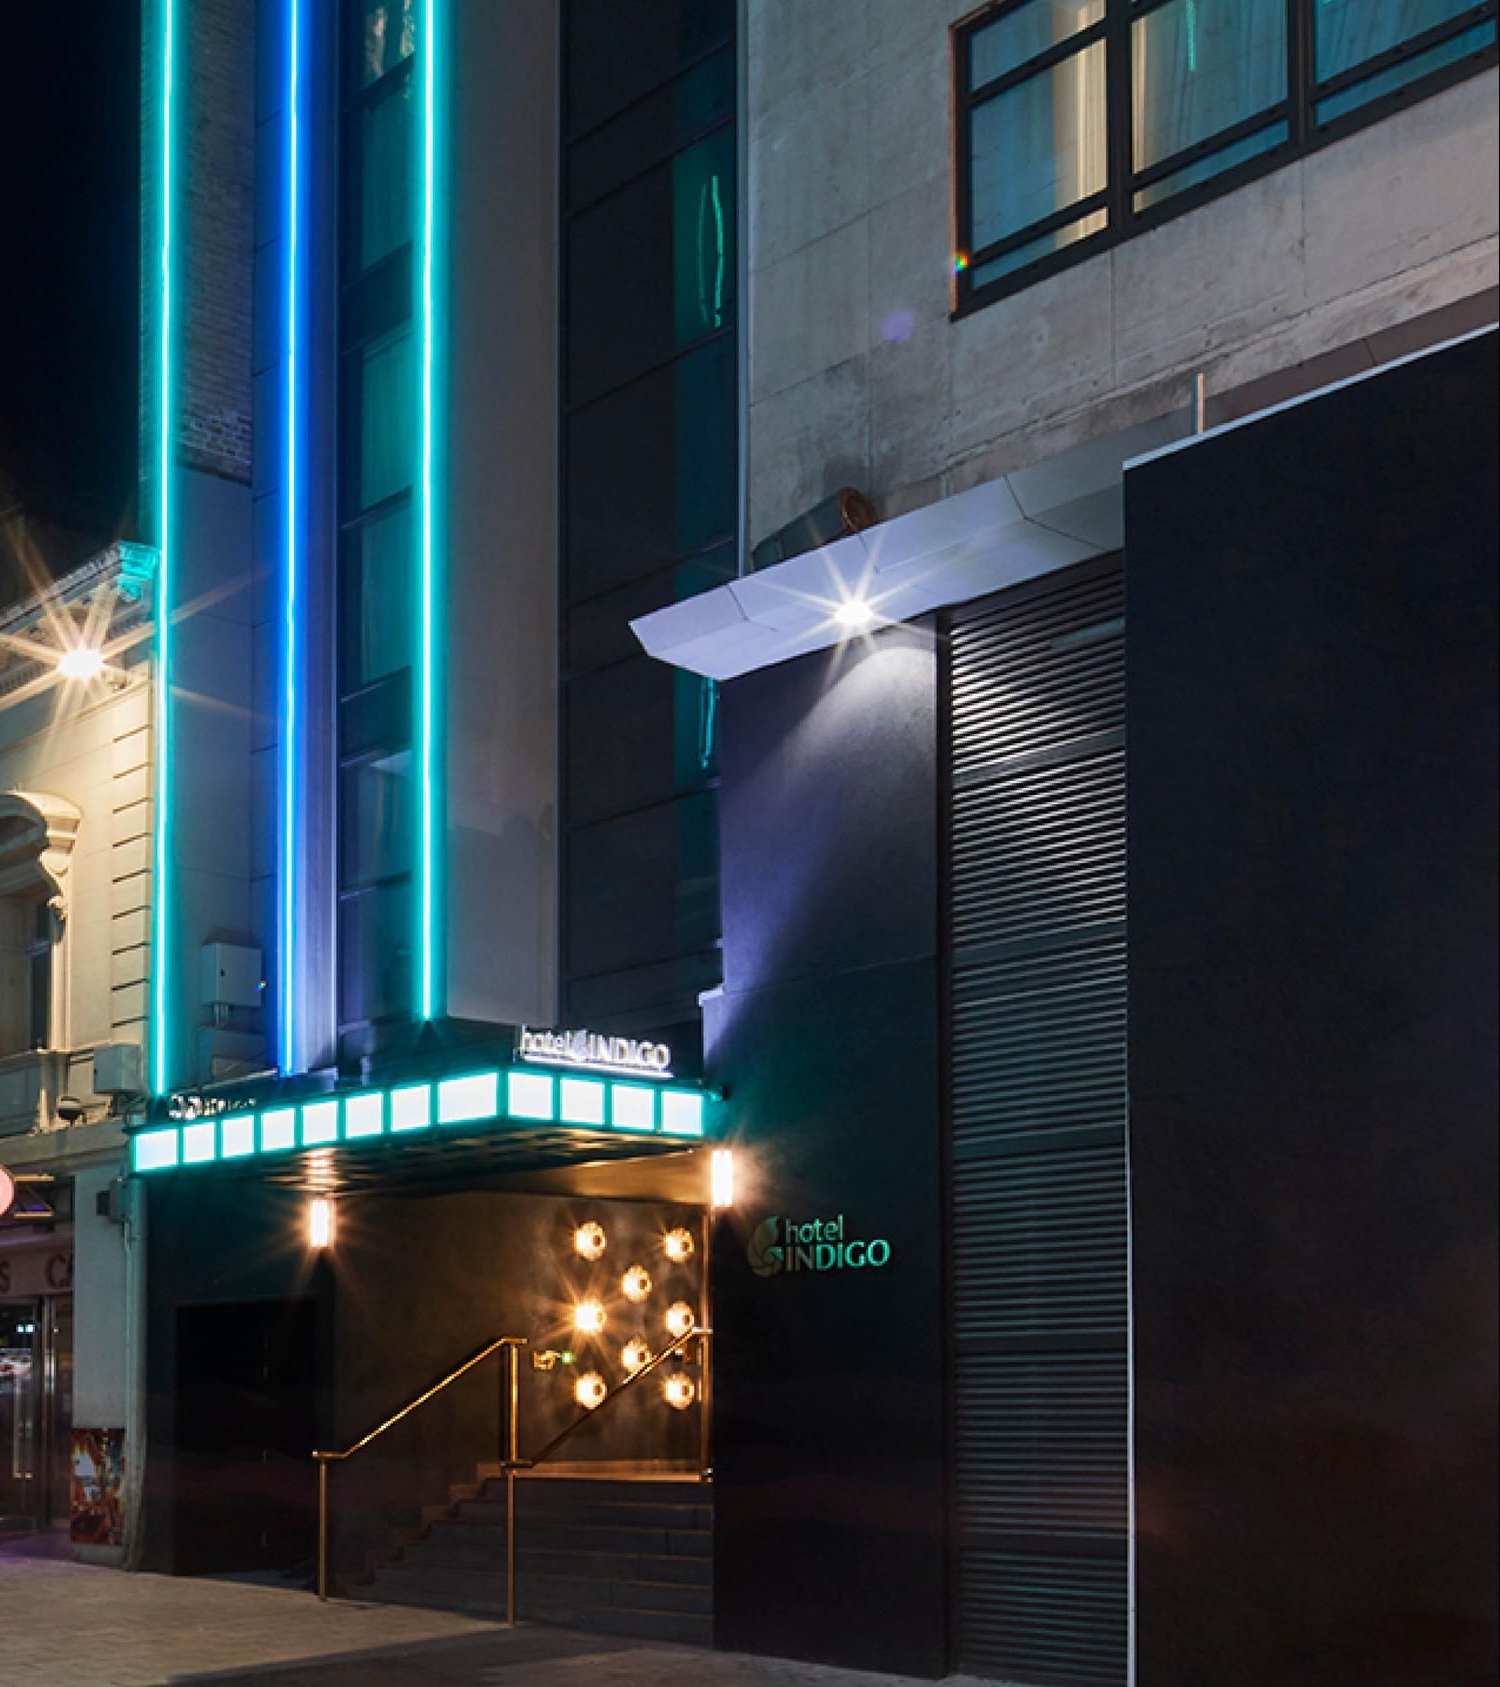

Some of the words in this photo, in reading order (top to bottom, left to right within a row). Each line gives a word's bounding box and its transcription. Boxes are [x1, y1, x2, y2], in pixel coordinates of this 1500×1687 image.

[521, 1024, 570, 1053] hotel
[590, 1033, 672, 1068] INDIGO
[785, 1214, 844, 1243] hotel
[785, 1239, 891, 1271] INDIGO
